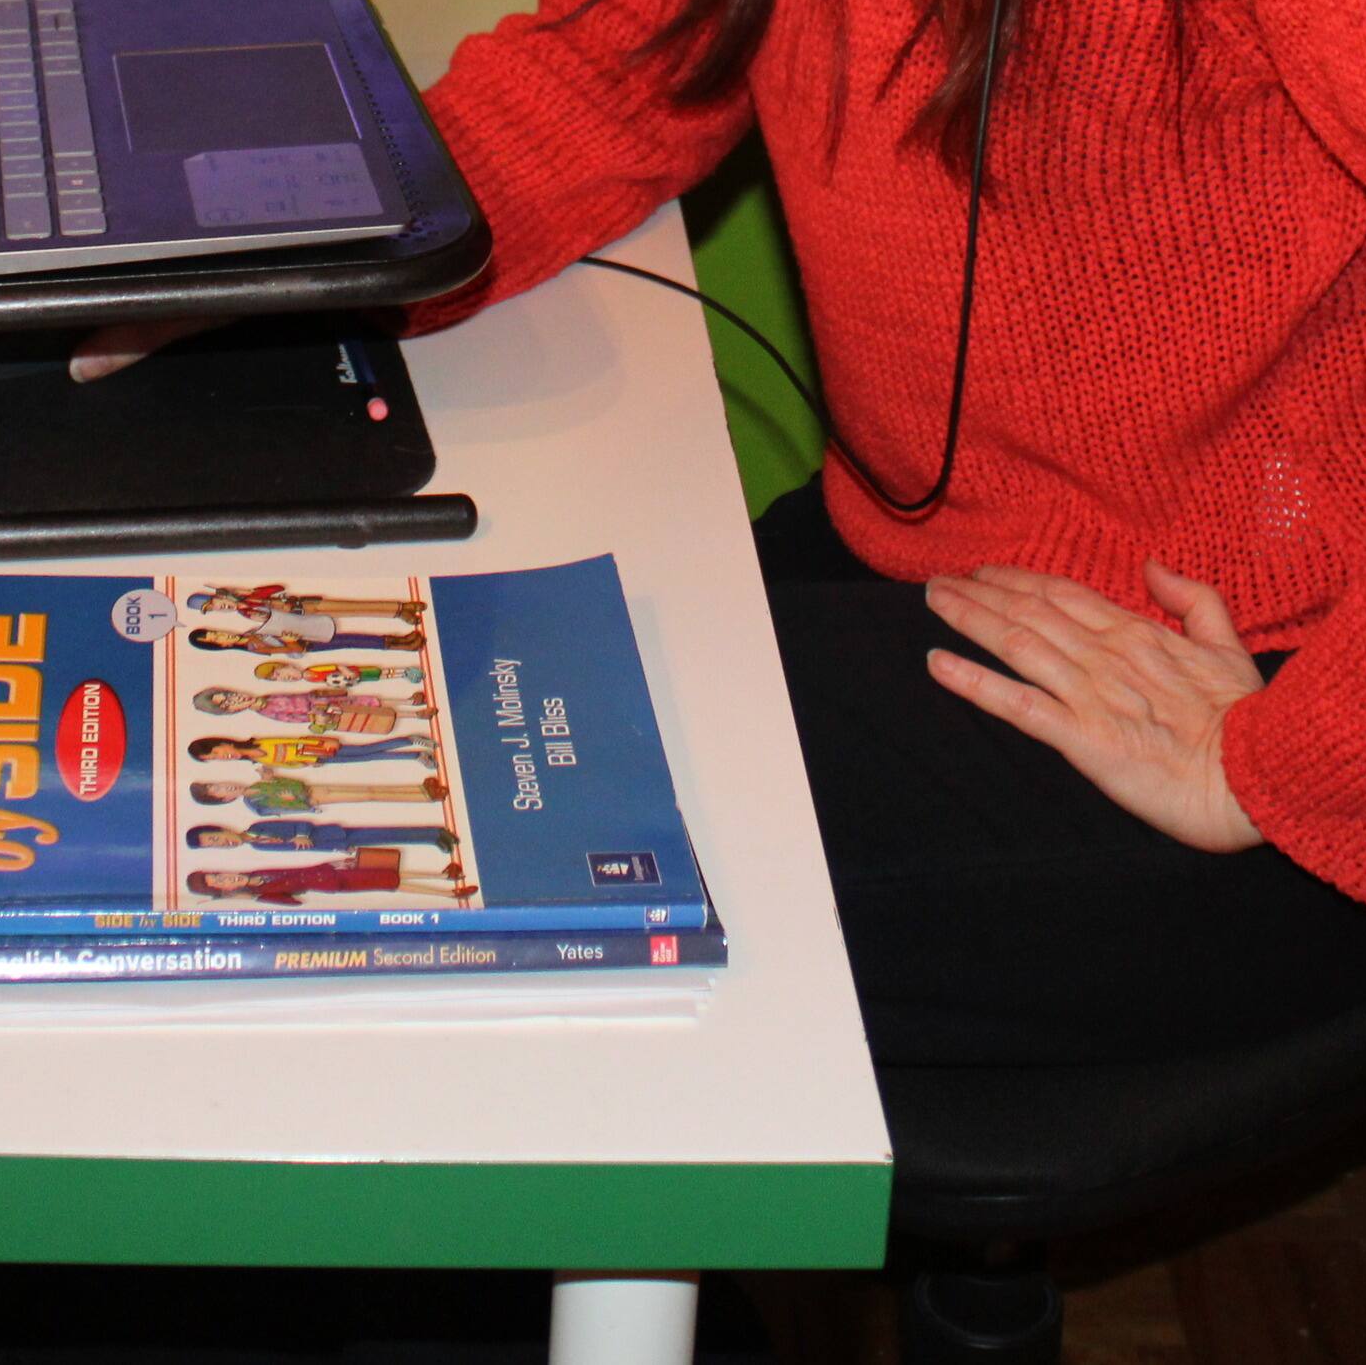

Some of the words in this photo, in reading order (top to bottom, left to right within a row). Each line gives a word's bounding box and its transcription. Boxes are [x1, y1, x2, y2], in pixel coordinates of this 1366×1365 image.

[126, 596, 142, 635] BOOK
[148, 612, 168, 620] 1
[488, 658, 526, 727] Molinsky
[82, 683, 101, 742] EDITION
[539, 697, 571, 737] Bliss
[501, 733, 531, 749] J.
[544, 741, 577, 766] Bill
[79, 747, 101, 794] THIRD
[513, 753, 543, 810] Steven
[94, 916, 133, 928] SIDE
[162, 915, 202, 928] SIDE
[217, 915, 267, 927] THIRD
[272, 914, 336, 926] EDITION
[379, 913, 424, 925] BOOK
[431, 913, 440, 924] 1
[75, 948, 243, 972] Conversation
[274, 951, 368, 970] PREMIUM
[373, 946, 434, 966] Second
[439, 945, 497, 964] Edition
[555, 944, 604, 960] Yates
